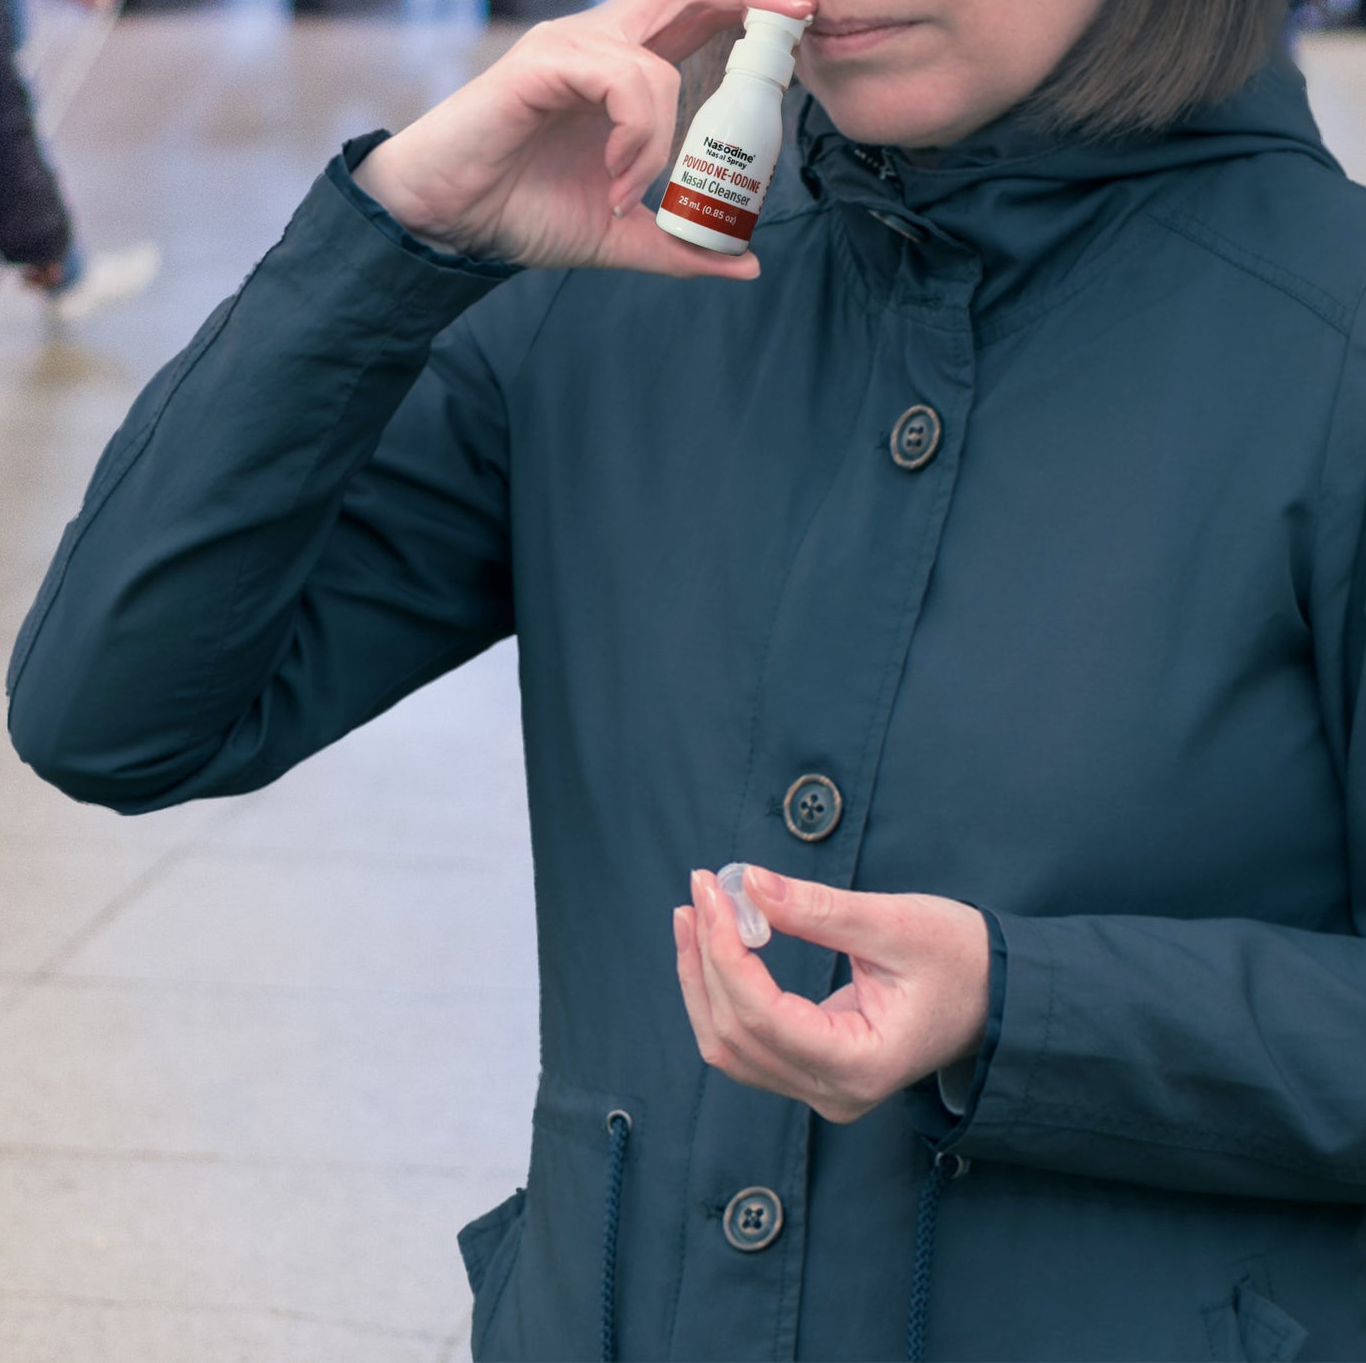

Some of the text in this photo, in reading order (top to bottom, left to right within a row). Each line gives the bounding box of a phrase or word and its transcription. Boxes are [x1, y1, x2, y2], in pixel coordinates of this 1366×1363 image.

[703, 136, 754, 164] Nasodine
[706, 149, 747, 170] Nasal Spray
[681, 170, 750, 207] Nasal Cleanser
[682, 154, 761, 194] POVIDONE-IODINE
[678, 195, 737, 226] 25 mL (0.85 oz)
